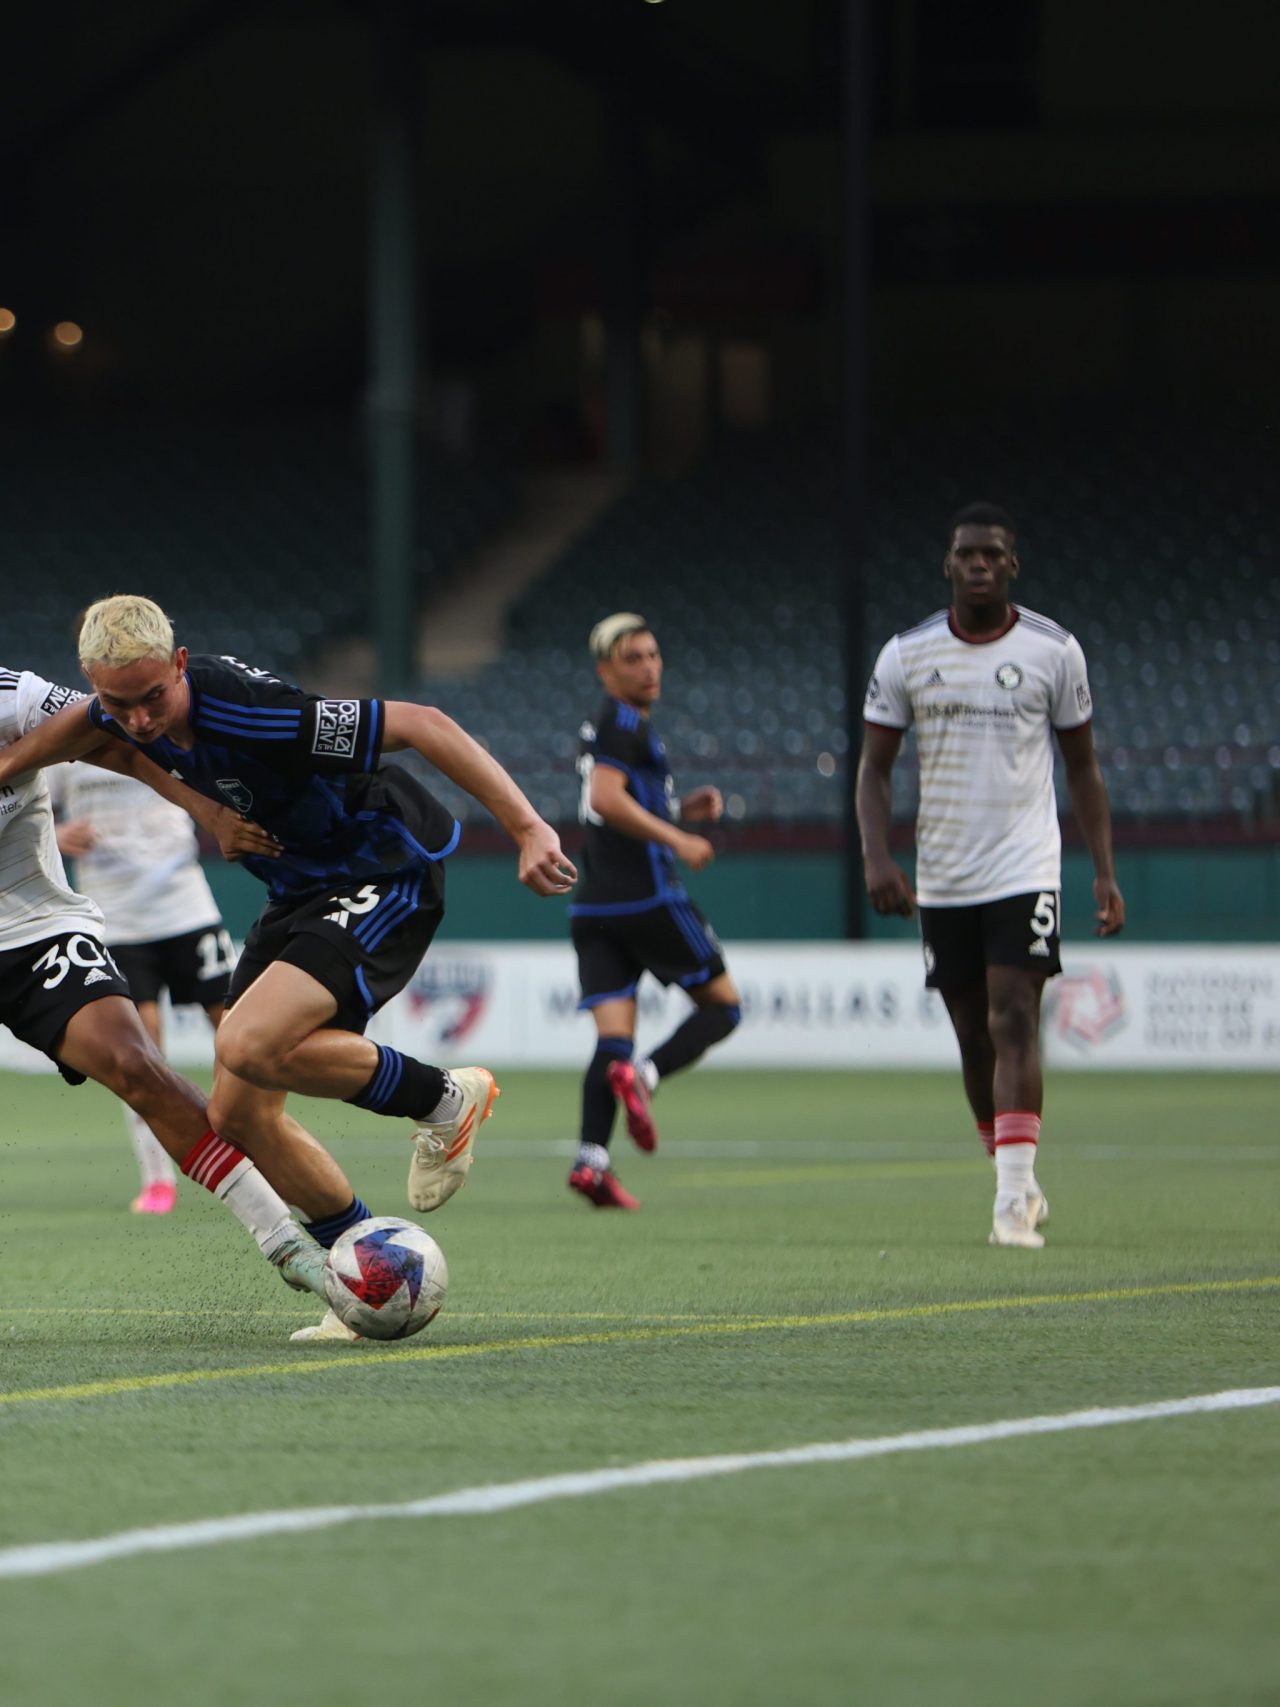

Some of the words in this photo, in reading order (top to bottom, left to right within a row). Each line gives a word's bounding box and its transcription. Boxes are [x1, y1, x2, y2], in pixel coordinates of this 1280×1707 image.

[319, 701, 338, 744] NEXT
[336, 702, 356, 735] PRO
[1030, 891, 1056, 938] 5
[32, 934, 107, 990] 30
